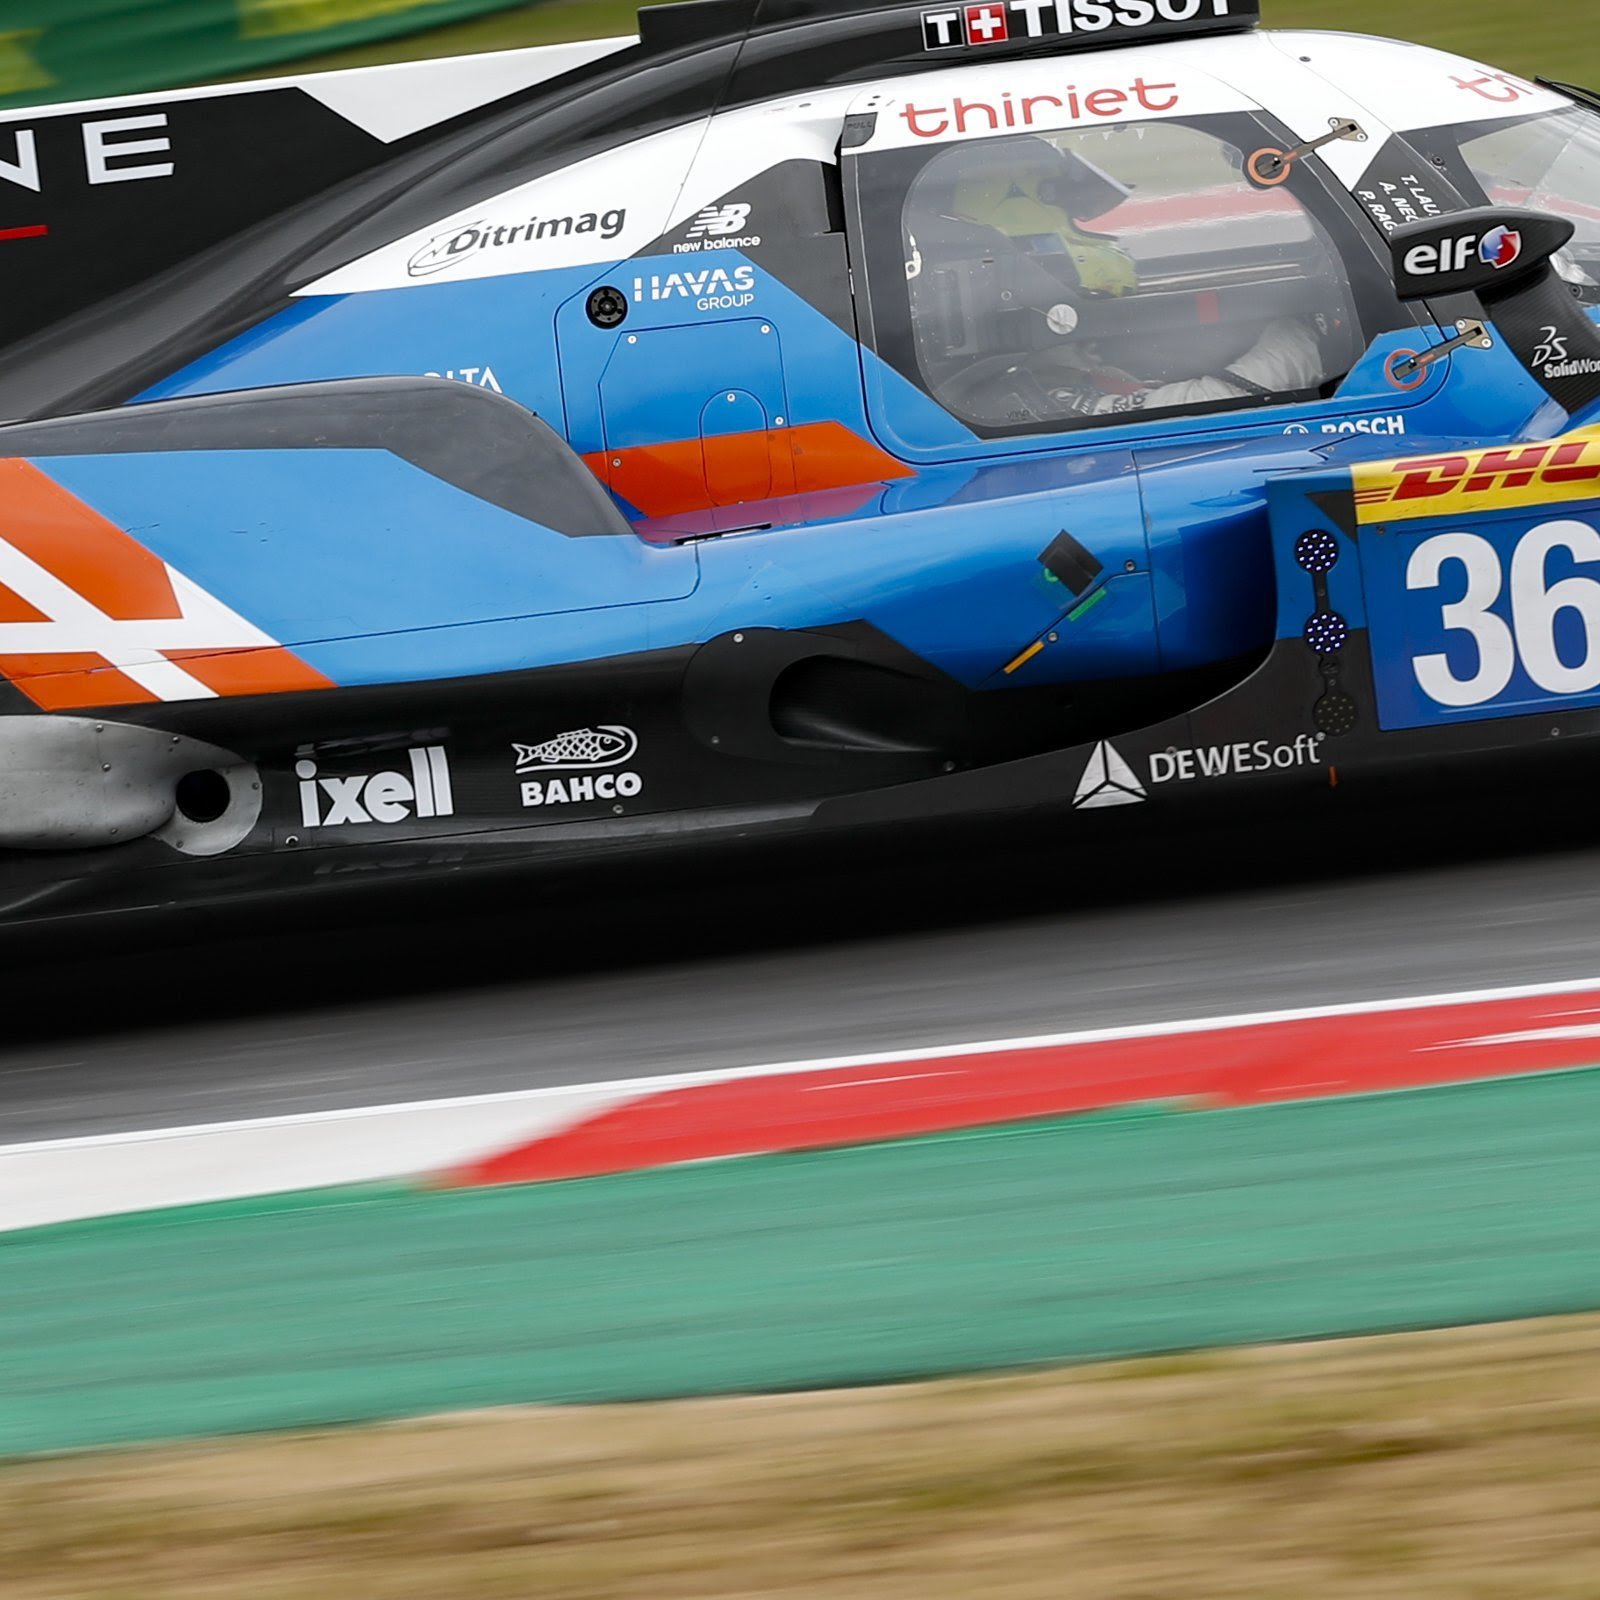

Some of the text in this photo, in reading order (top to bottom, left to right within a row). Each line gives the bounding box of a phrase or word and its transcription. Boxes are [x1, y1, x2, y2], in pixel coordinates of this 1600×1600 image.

[899, 78, 1179, 138] thiriet
[447, 208, 626, 255] Ditrimag
[673, 236, 761, 254] new balance
[1403, 234, 1477, 275] elf
[634, 266, 755, 302] HAVAS
[697, 293, 754, 311] GROUP
[295, 745, 454, 828] ixell
[520, 772, 642, 807] BAHCO
